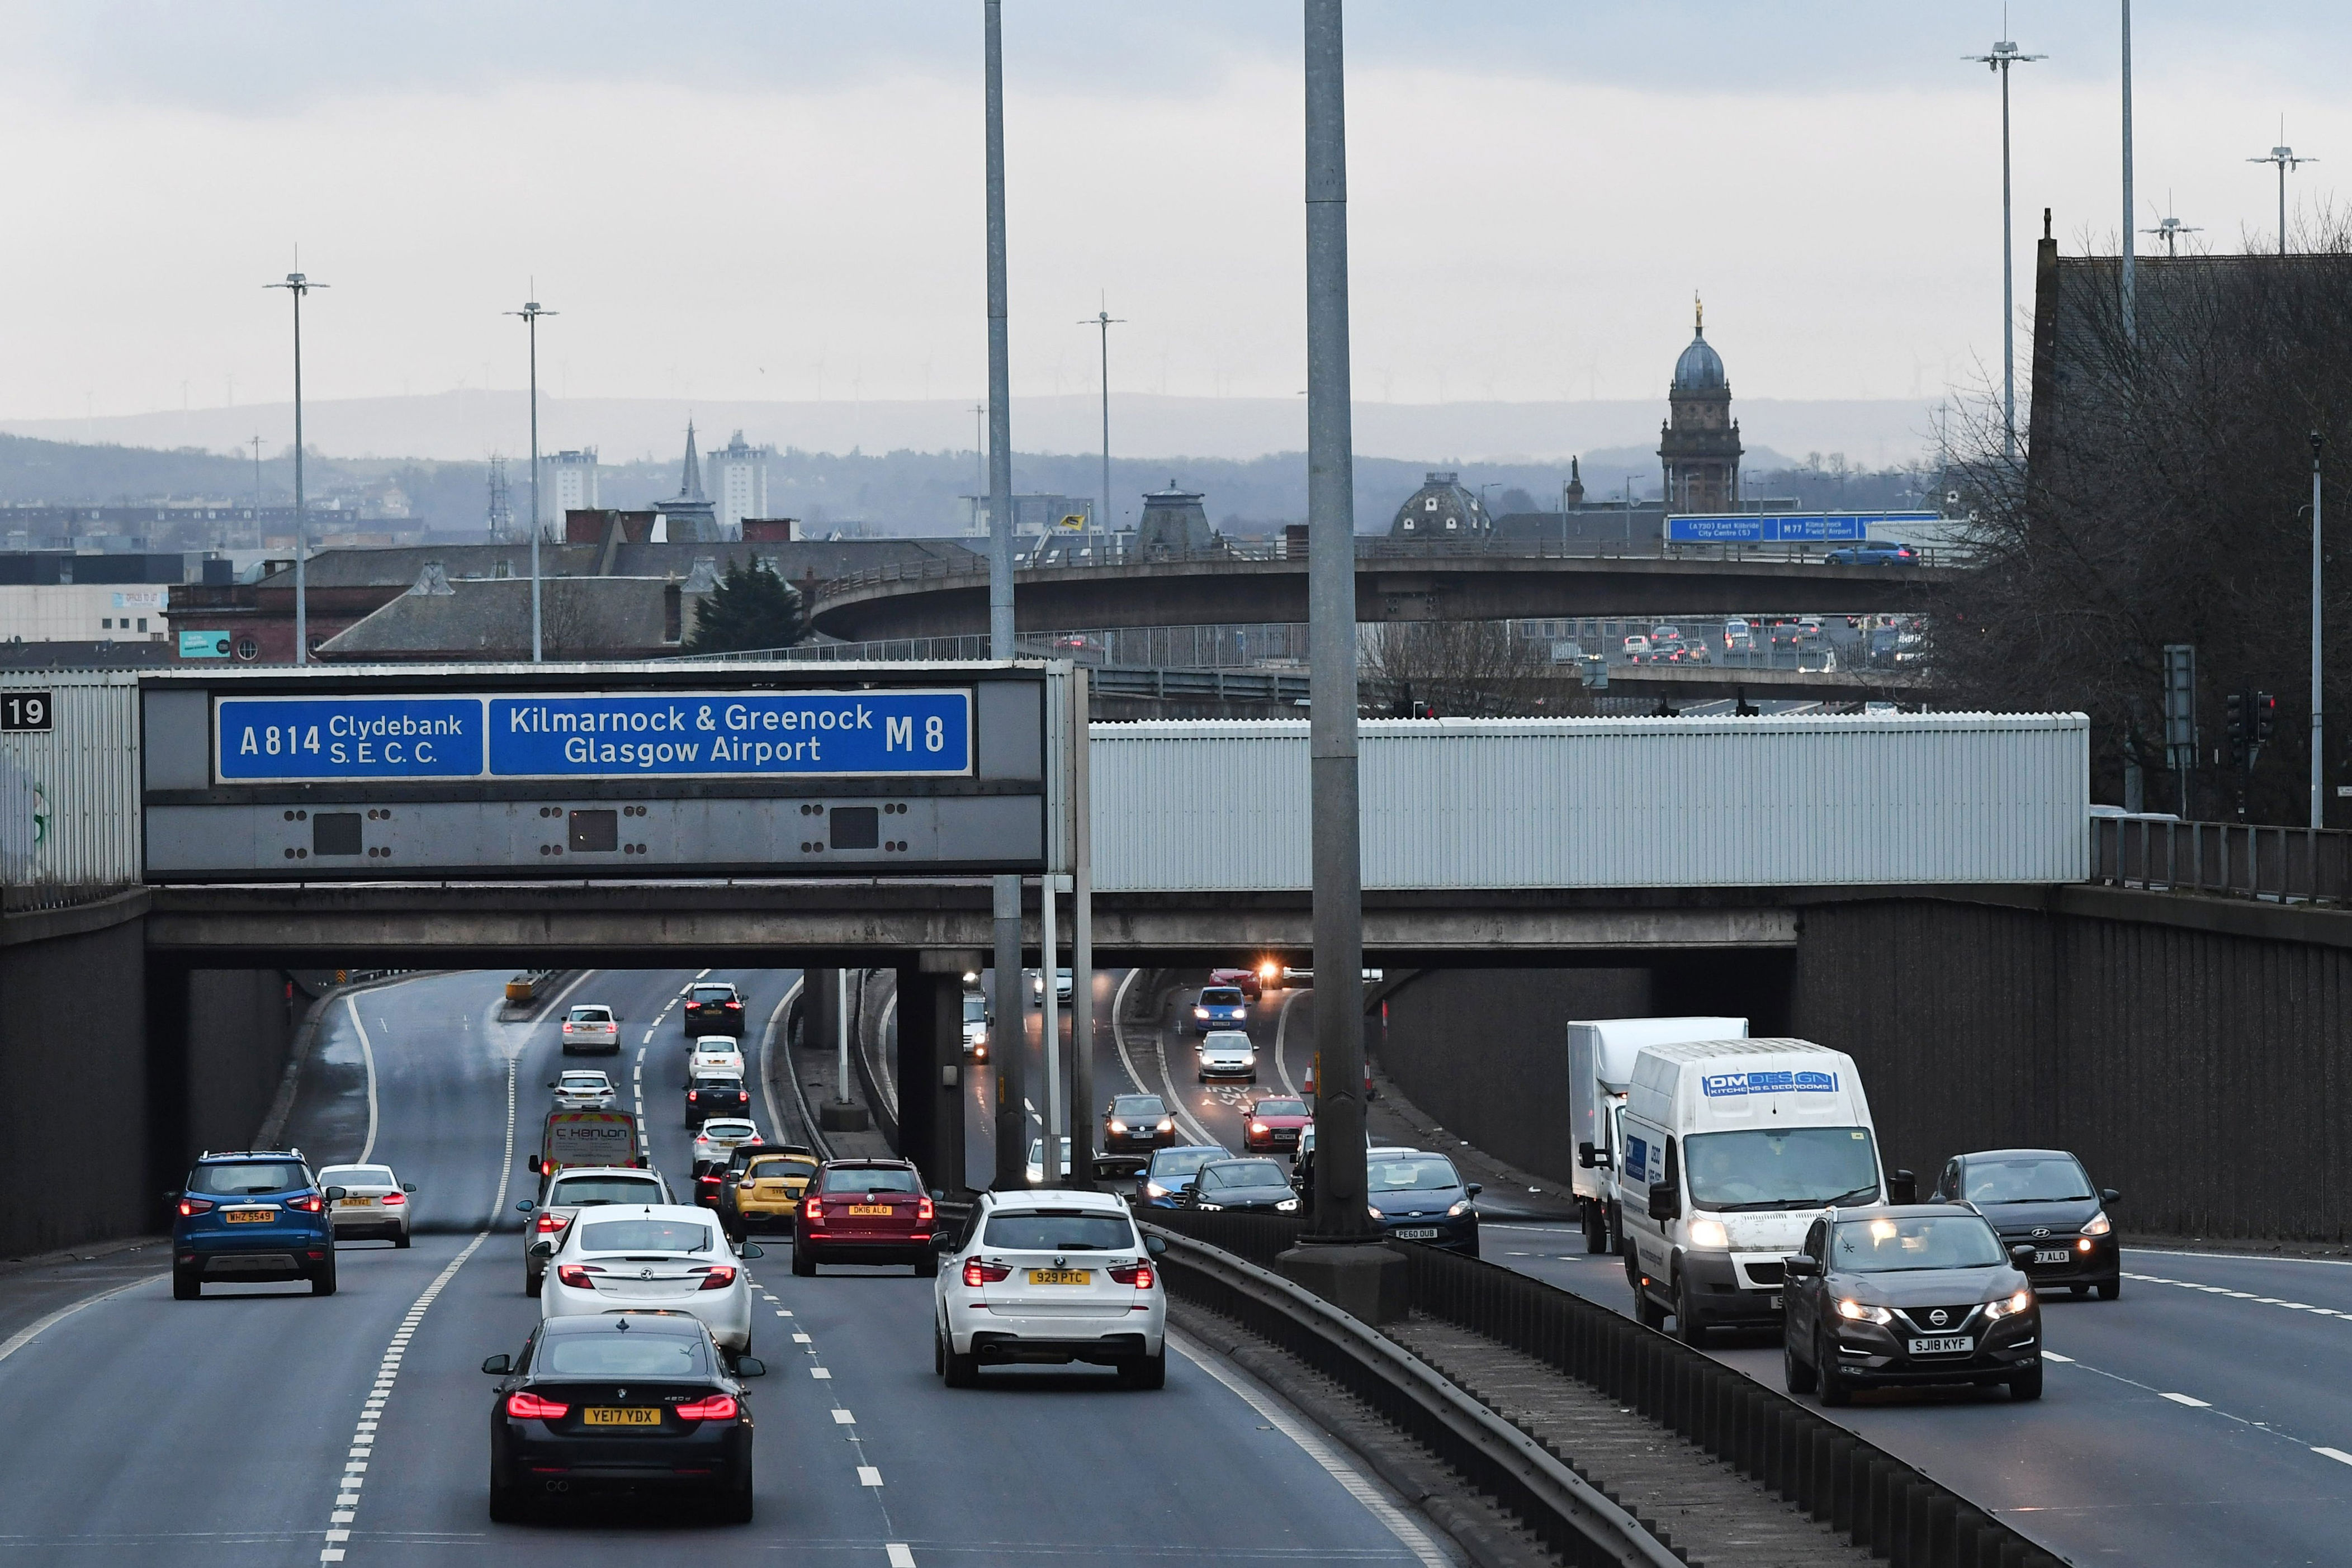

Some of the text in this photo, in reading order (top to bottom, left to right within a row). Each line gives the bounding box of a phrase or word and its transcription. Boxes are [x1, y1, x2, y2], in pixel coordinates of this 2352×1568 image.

[9, 699, 44, 724] 19
[511, 704, 873, 732] Kilmarnock & Greenock
[329, 715, 462, 741] Clydebank
[565, 736, 821, 768] Glasgow Airport
[556, 1129, 566, 1137] C
[230, 1212, 271, 1221] WHZ 5549
[2047, 1252, 2065, 1261] ALO
[1037, 1272, 1082, 1282] 929 PTC
[1915, 1338, 1966, 1351] SJ18 KYF
[593, 1410, 652, 1423] YE17 YDX
